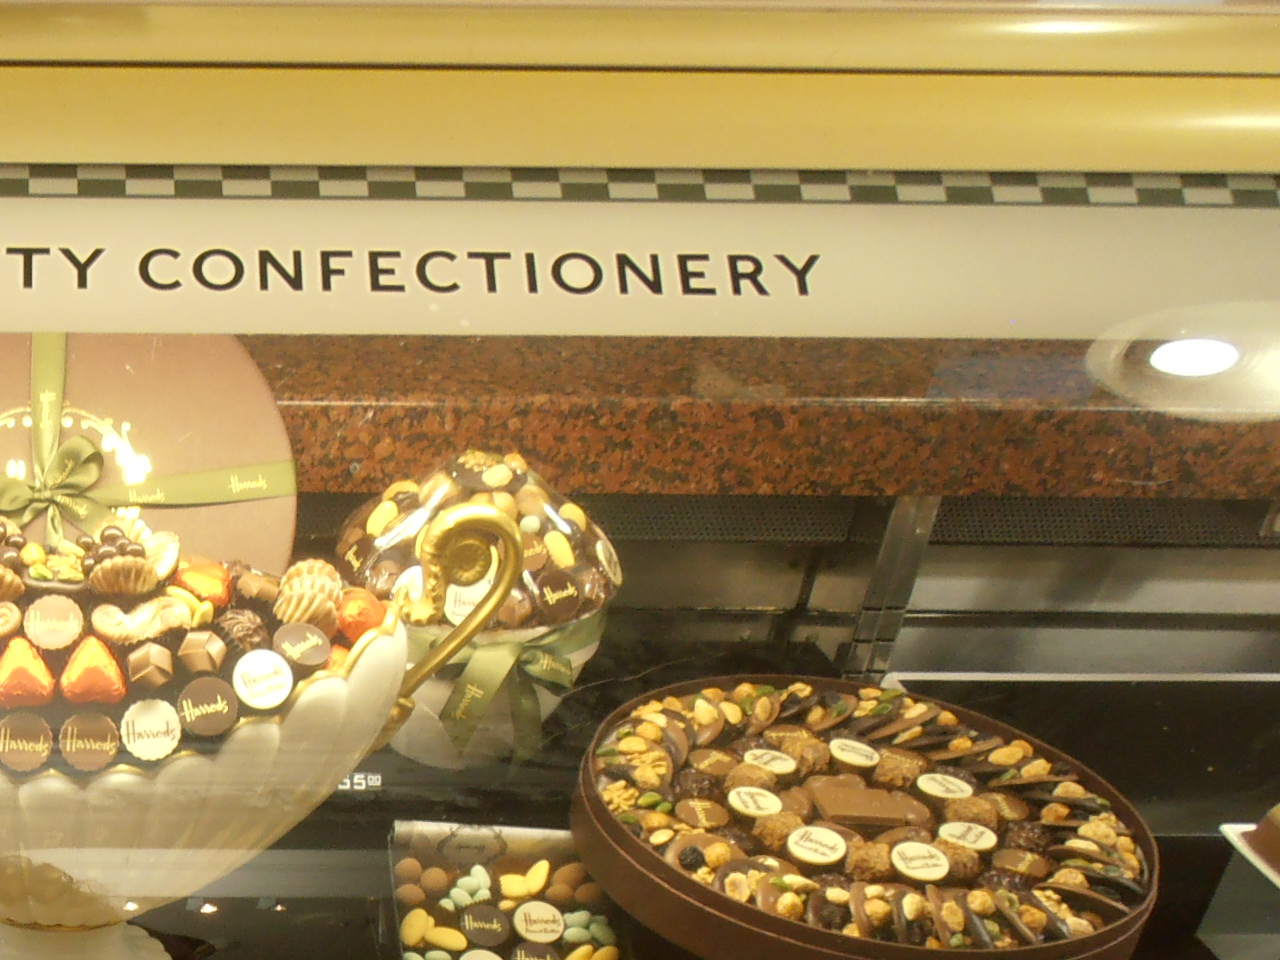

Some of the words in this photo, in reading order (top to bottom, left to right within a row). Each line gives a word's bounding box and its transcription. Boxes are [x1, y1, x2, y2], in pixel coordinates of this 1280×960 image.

[137, 247, 822, 298] CONFECTIONERY
[228, 474, 267, 494] Harrods
[180, 695, 228, 723] Harrods
[64, 726, 116, 755] Harrods
[123, 719, 176, 746] Harrods
[460, 914, 503, 932] Harrods
